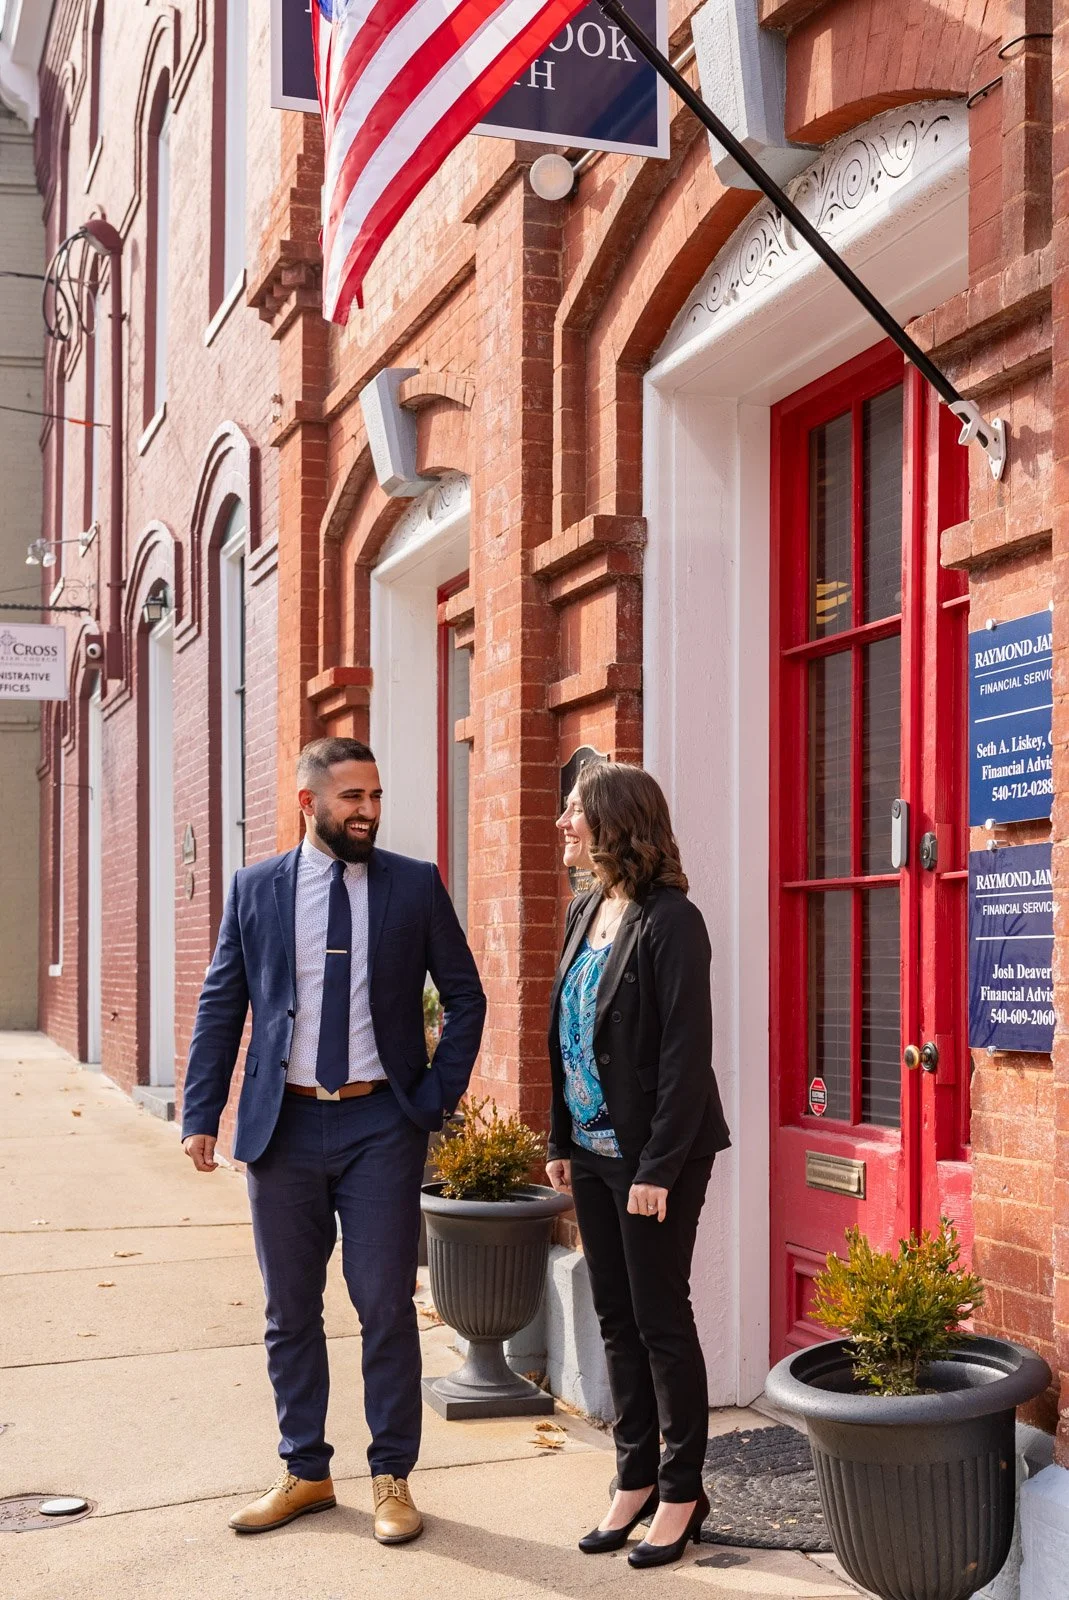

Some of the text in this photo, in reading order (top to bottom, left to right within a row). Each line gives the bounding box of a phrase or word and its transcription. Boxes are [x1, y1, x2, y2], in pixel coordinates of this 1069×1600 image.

[975, 639, 1033, 669] RAYMOND
[980, 676, 1022, 695] FINANCIAL
[976, 743, 997, 759] Seth
[999, 739, 1010, 754] A.
[1012, 734, 1046, 752] Liskey,
[981, 759, 1025, 780] Financial
[992, 778, 1053, 801] 540-712-0288
[976, 870, 1031, 890] RAYMOND
[983, 903, 1021, 916] FINANCIAL
[992, 963, 1052, 979] Josh Deaver
[980, 986, 1025, 1002] Financial
[990, 1008, 1055, 1025] 540-609-2060
